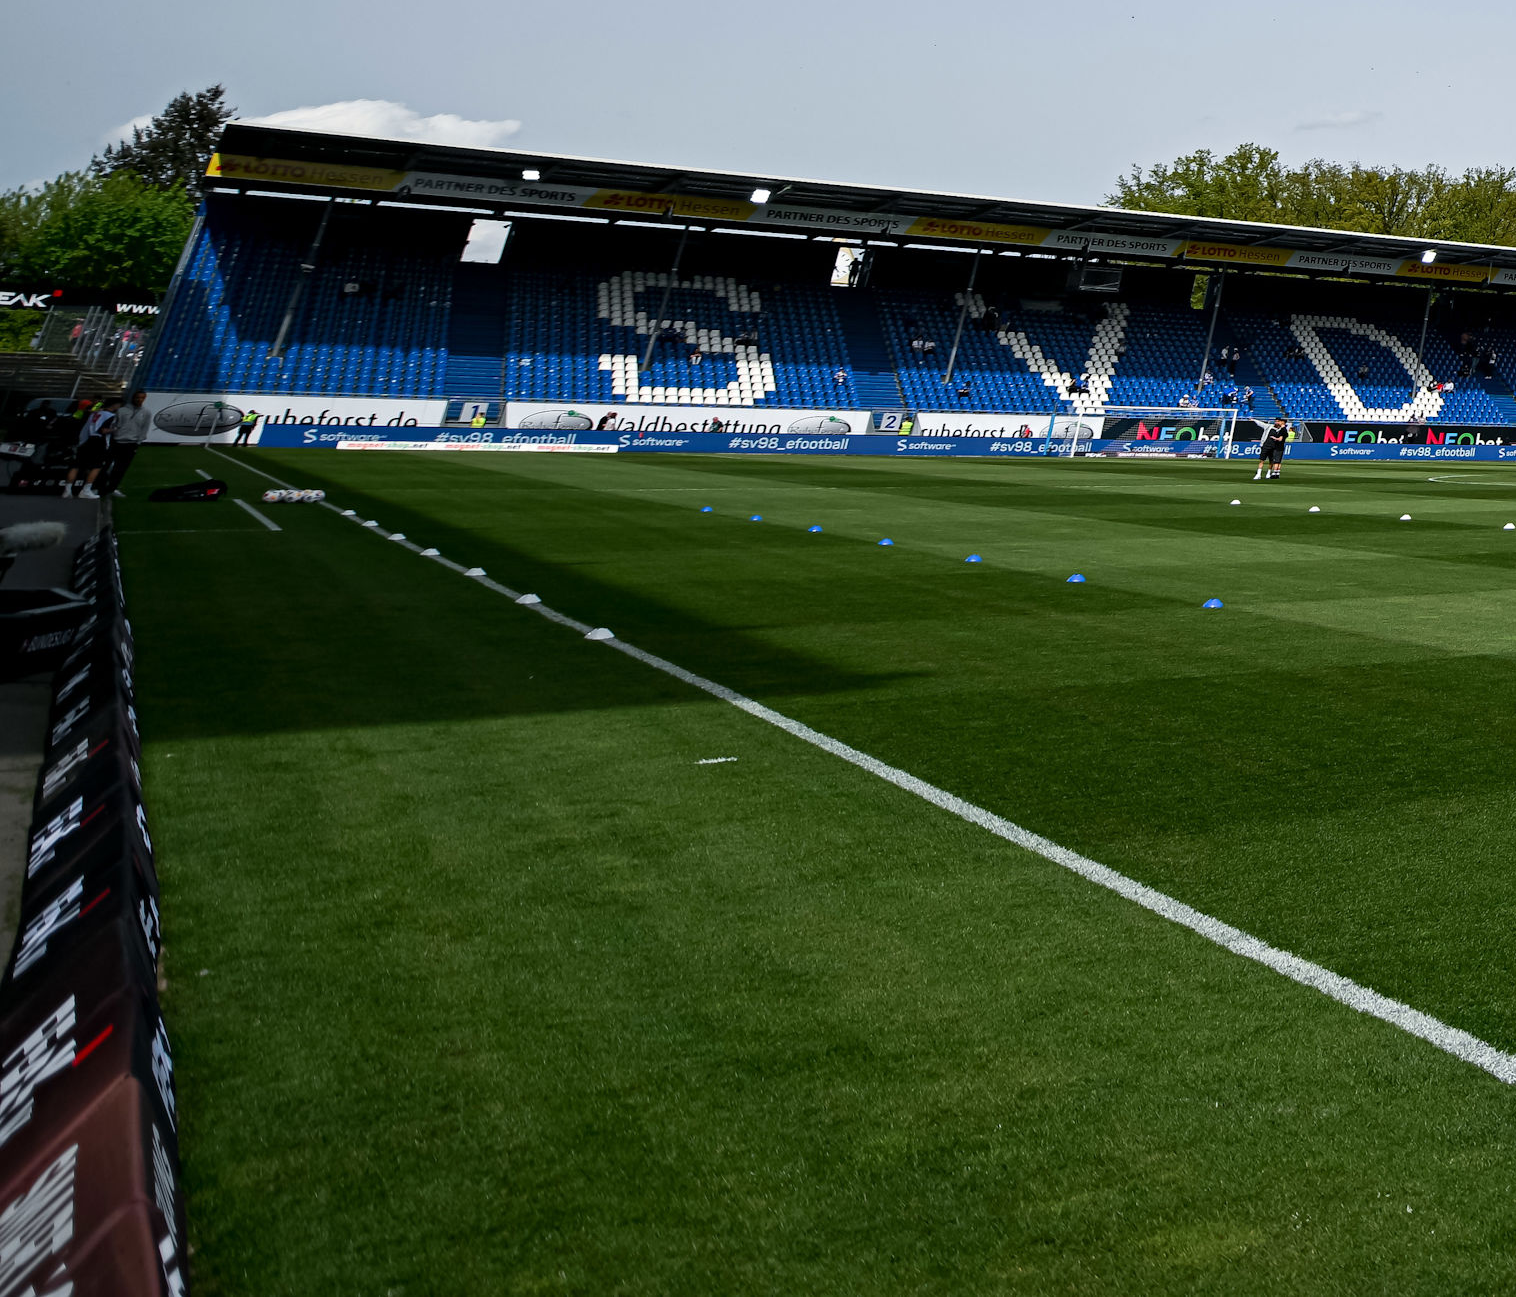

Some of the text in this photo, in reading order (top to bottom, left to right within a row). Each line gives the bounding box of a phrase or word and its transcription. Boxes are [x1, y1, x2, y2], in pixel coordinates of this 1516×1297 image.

[1056, 234, 1168, 252] PARTNER DES SPORTS
[1298, 254, 1392, 270] PARTNER DES SPORTS
[471, 405, 479, 415] 1
[254, 408, 418, 427] ruheforstde
[886, 416, 897, 428] 2
[614, 416, 781, 434] aldbestttung
[319, 433, 378, 441] software
[434, 432, 576, 444] #sv98efootball
[632, 437, 683, 446] software
[909, 442, 950, 450] software
[1133, 444, 1170, 453] software
